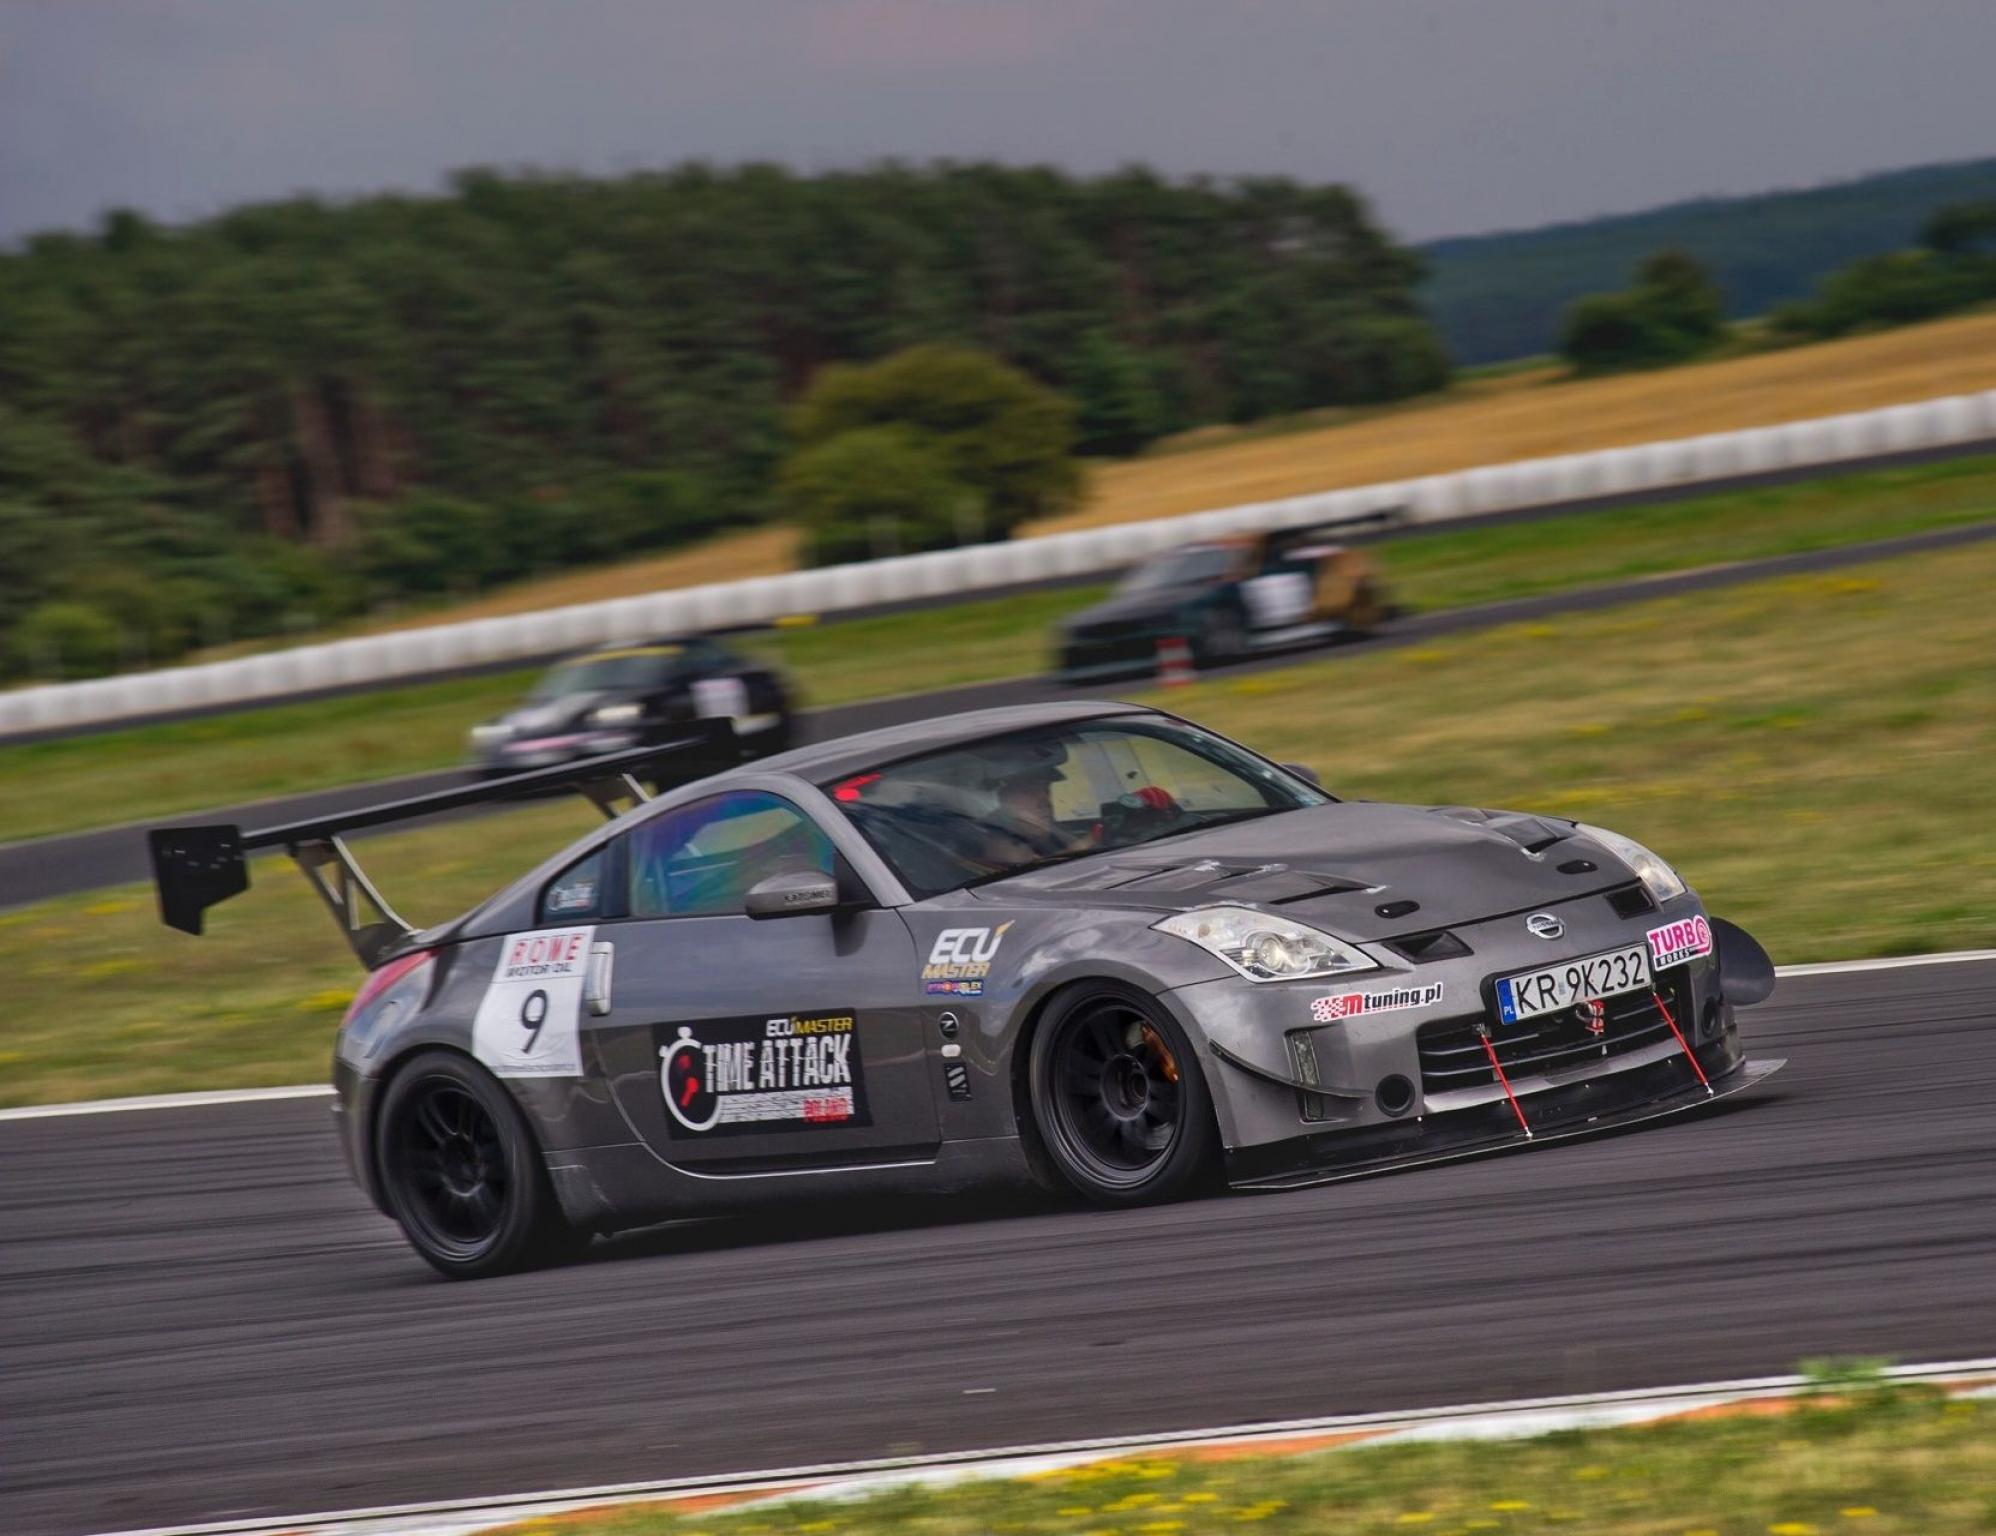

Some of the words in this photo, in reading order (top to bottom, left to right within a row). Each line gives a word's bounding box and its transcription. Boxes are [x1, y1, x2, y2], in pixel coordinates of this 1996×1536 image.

[509, 934, 585, 966] ROWE
[928, 923, 1006, 965] ECU
[921, 962, 991, 979] MASTER
[1515, 973, 1559, 1014] KR
[1566, 951, 1645, 1001] 9K232
[521, 989, 548, 1054] 9
[1504, 1005, 1514, 1016] PL
[702, 1041, 755, 1093] TIME
[759, 1033, 851, 1089] ATTACK
